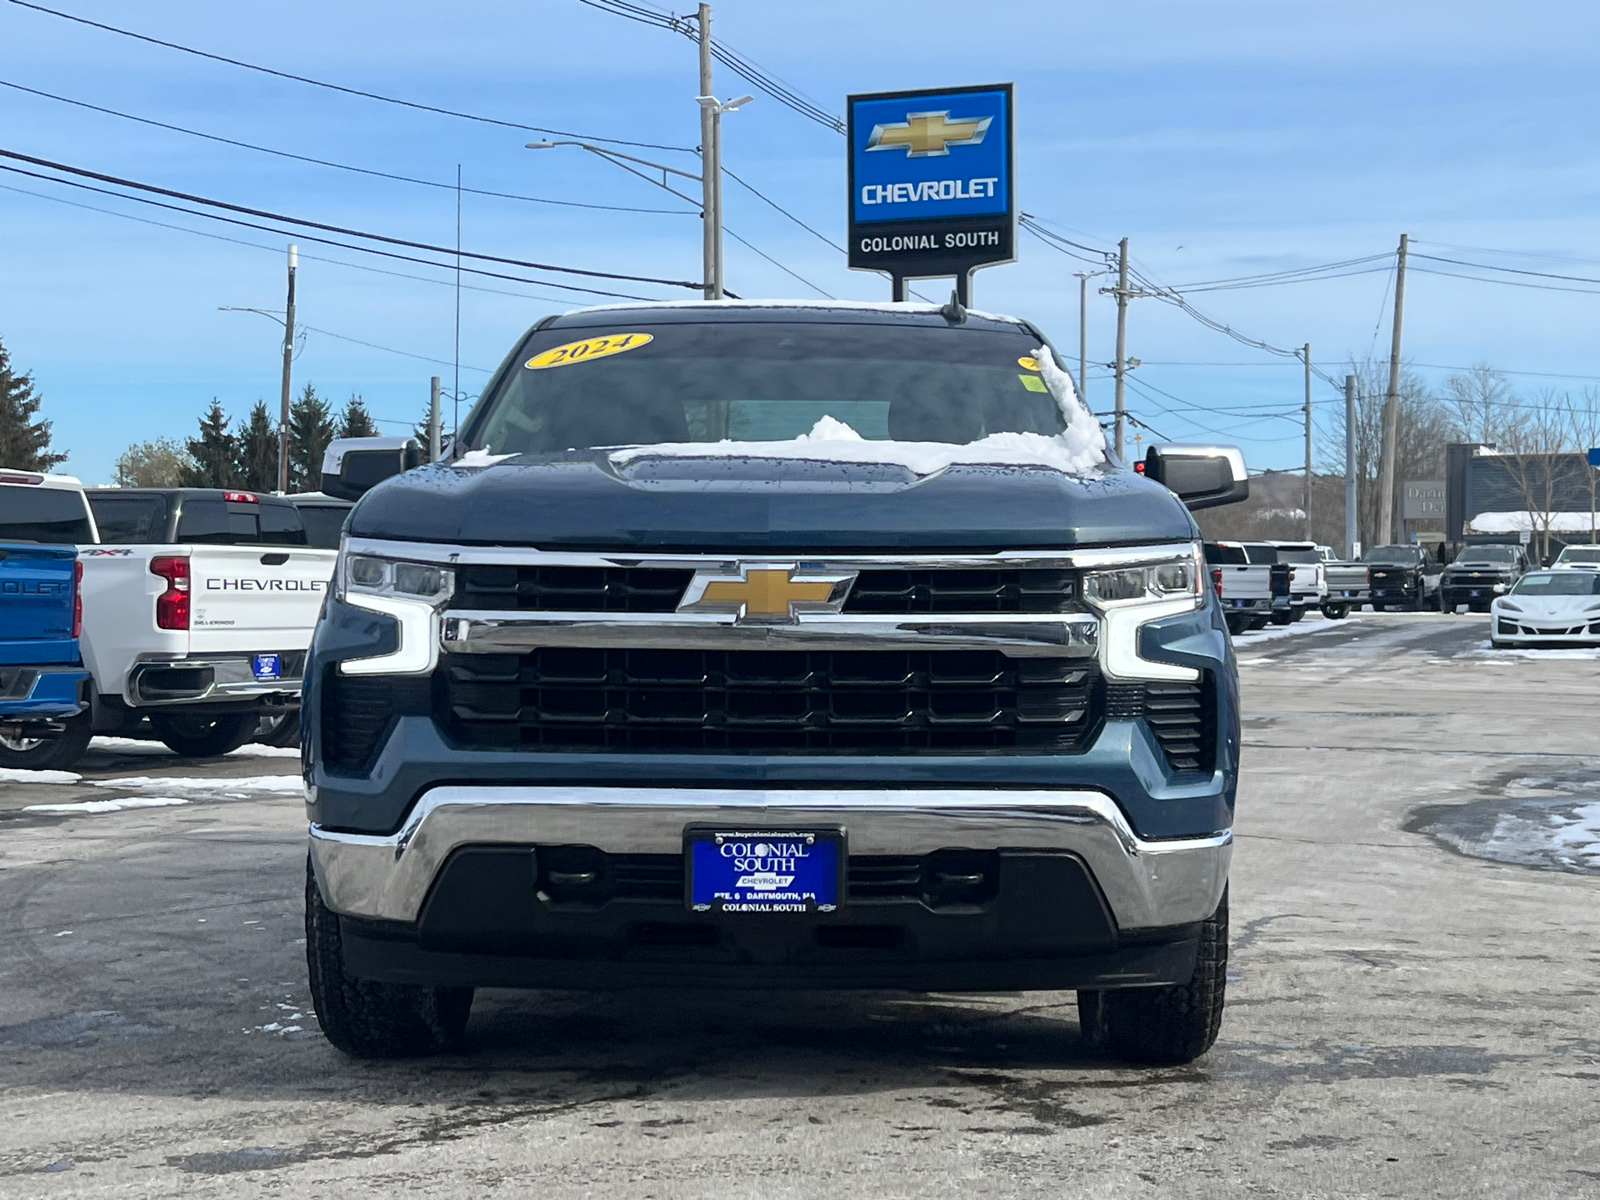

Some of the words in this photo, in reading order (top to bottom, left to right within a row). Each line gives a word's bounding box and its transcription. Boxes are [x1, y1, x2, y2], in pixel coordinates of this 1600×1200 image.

[861, 177, 999, 205] CHEVROLET
[860, 234, 940, 253] COLONIAL
[944, 231, 999, 248] SOUTH
[547, 334, 635, 365] 2024
[720, 843, 810, 857] COLONIAL
[734, 858, 795, 871] SOUTH
[734, 892, 741, 900] 6
[746, 892, 801, 901] DARTMOUTH,
